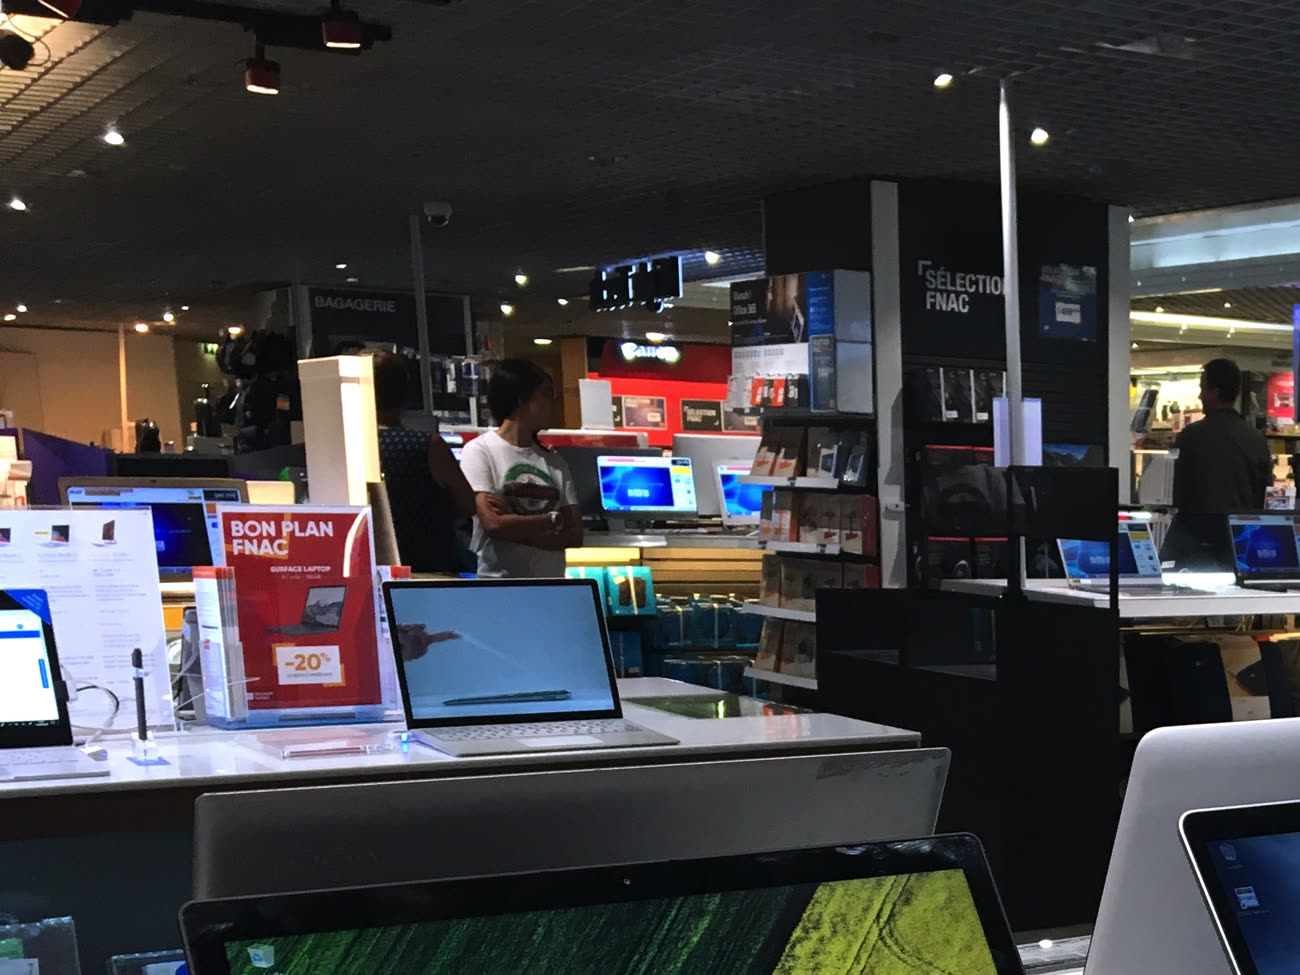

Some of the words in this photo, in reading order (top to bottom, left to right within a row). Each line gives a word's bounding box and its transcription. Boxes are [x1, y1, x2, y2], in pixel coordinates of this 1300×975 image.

[925, 267, 1005, 296] SÉLECTIO
[315, 294, 396, 313] BAGAGERIE
[925, 291, 969, 313] FNAC
[230, 520, 276, 537] BON
[281, 520, 334, 537] PLAN
[233, 539, 289, 555] FNAC
[270, 565, 302, 573] SURFACE
[303, 565, 331, 573] LAPTOP
[284, 652, 331, 671] -20%
